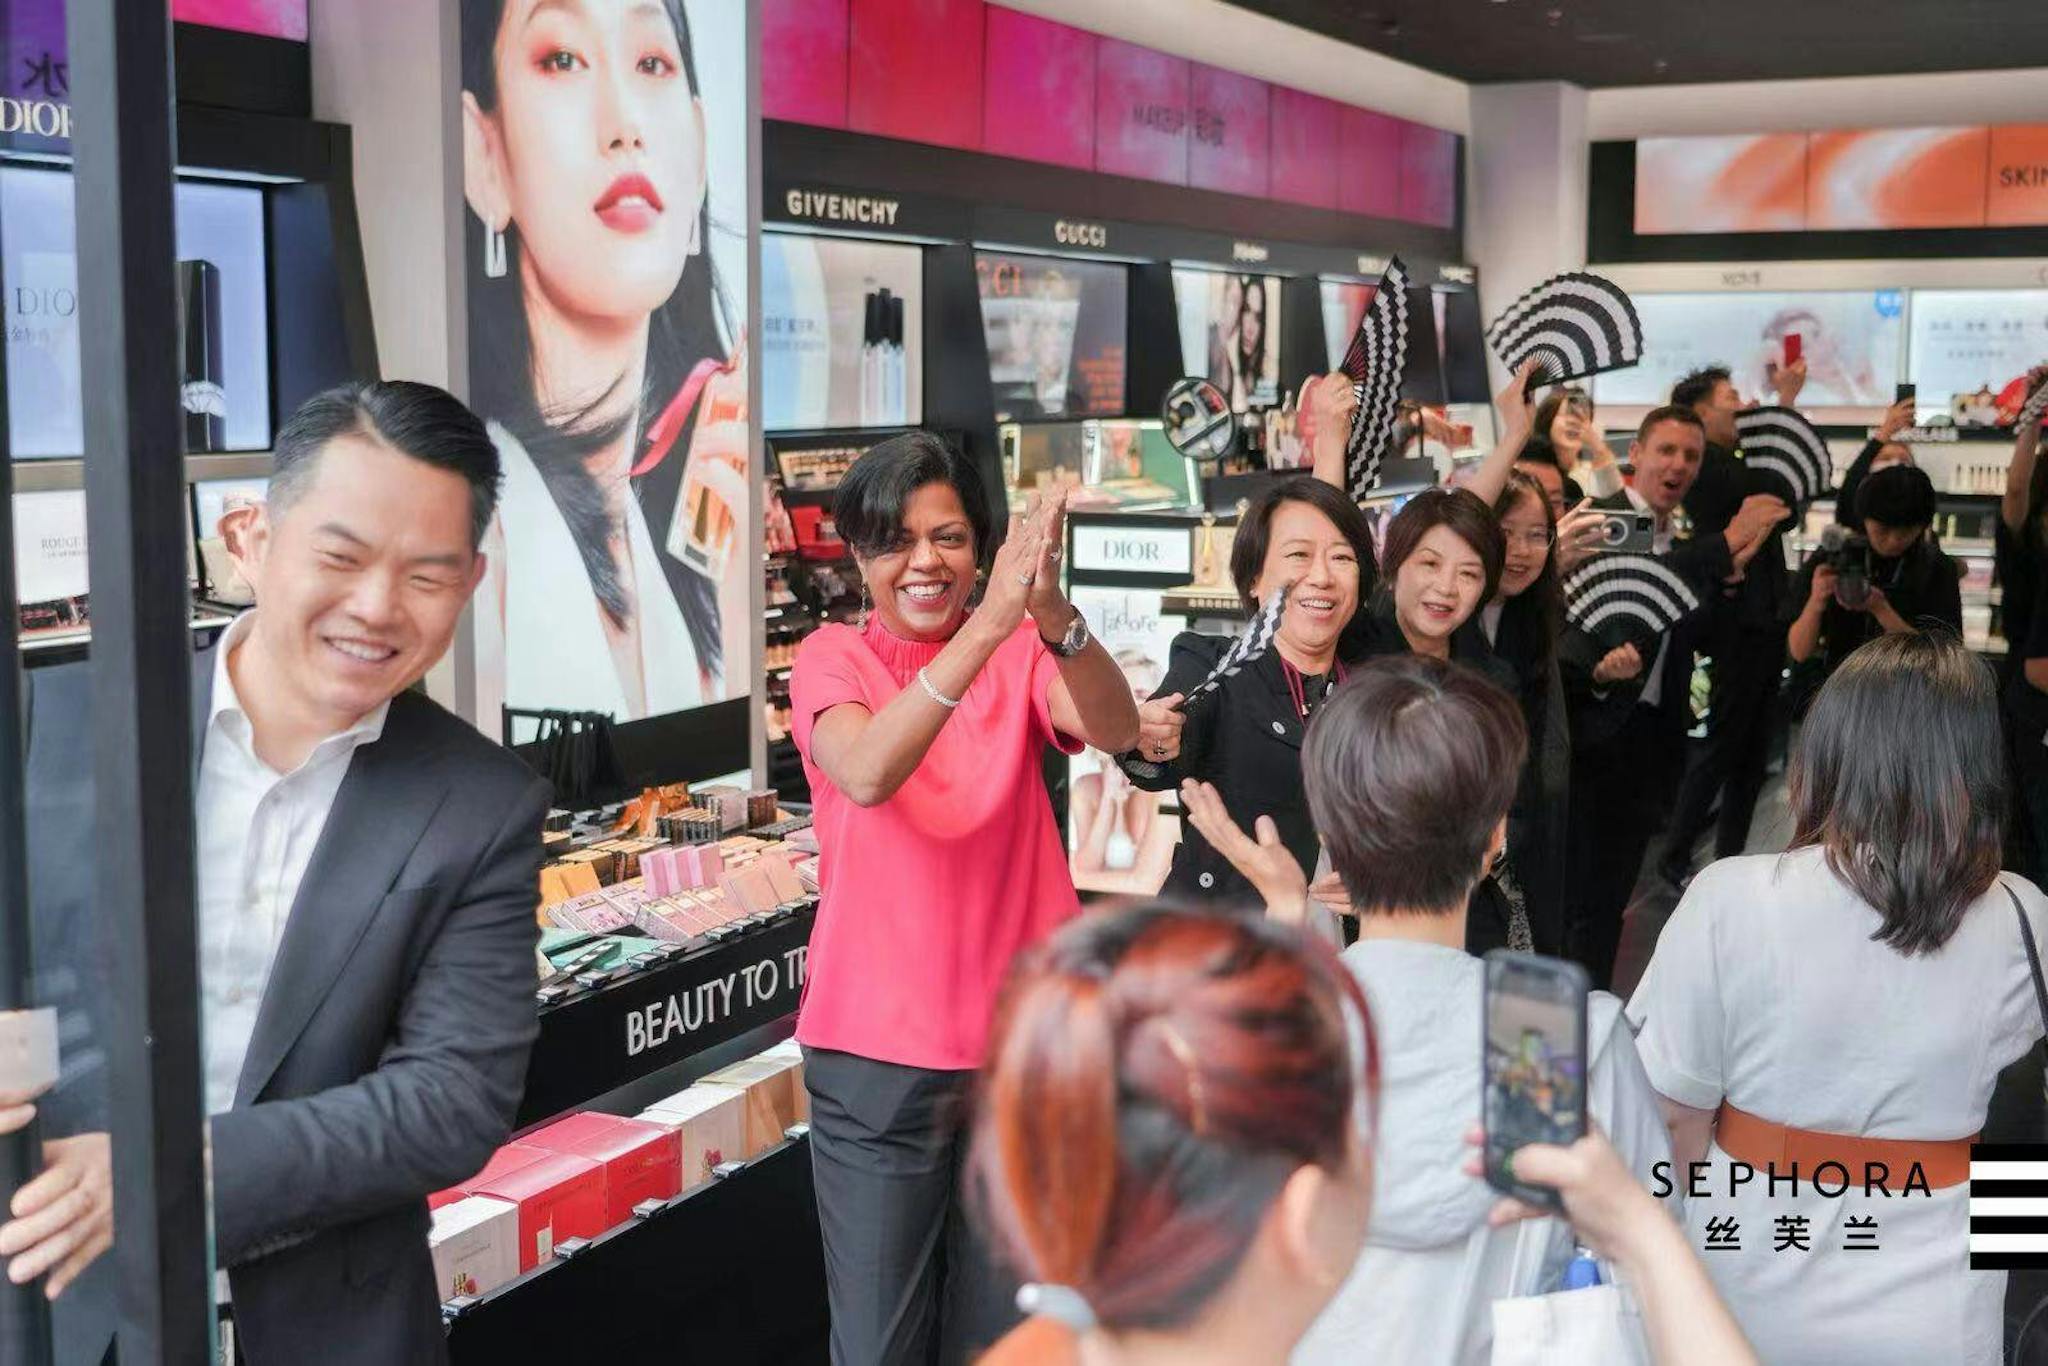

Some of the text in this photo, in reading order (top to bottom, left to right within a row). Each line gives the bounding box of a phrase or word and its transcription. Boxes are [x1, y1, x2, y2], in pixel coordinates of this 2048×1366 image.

[786, 190, 899, 225] GIVENCHY
[1054, 219, 1106, 248] GUCCI
[1103, 540, 1160, 561] DIOR
[627, 973, 737, 1057] BEAUTY
[741, 959, 779, 1008] TO
